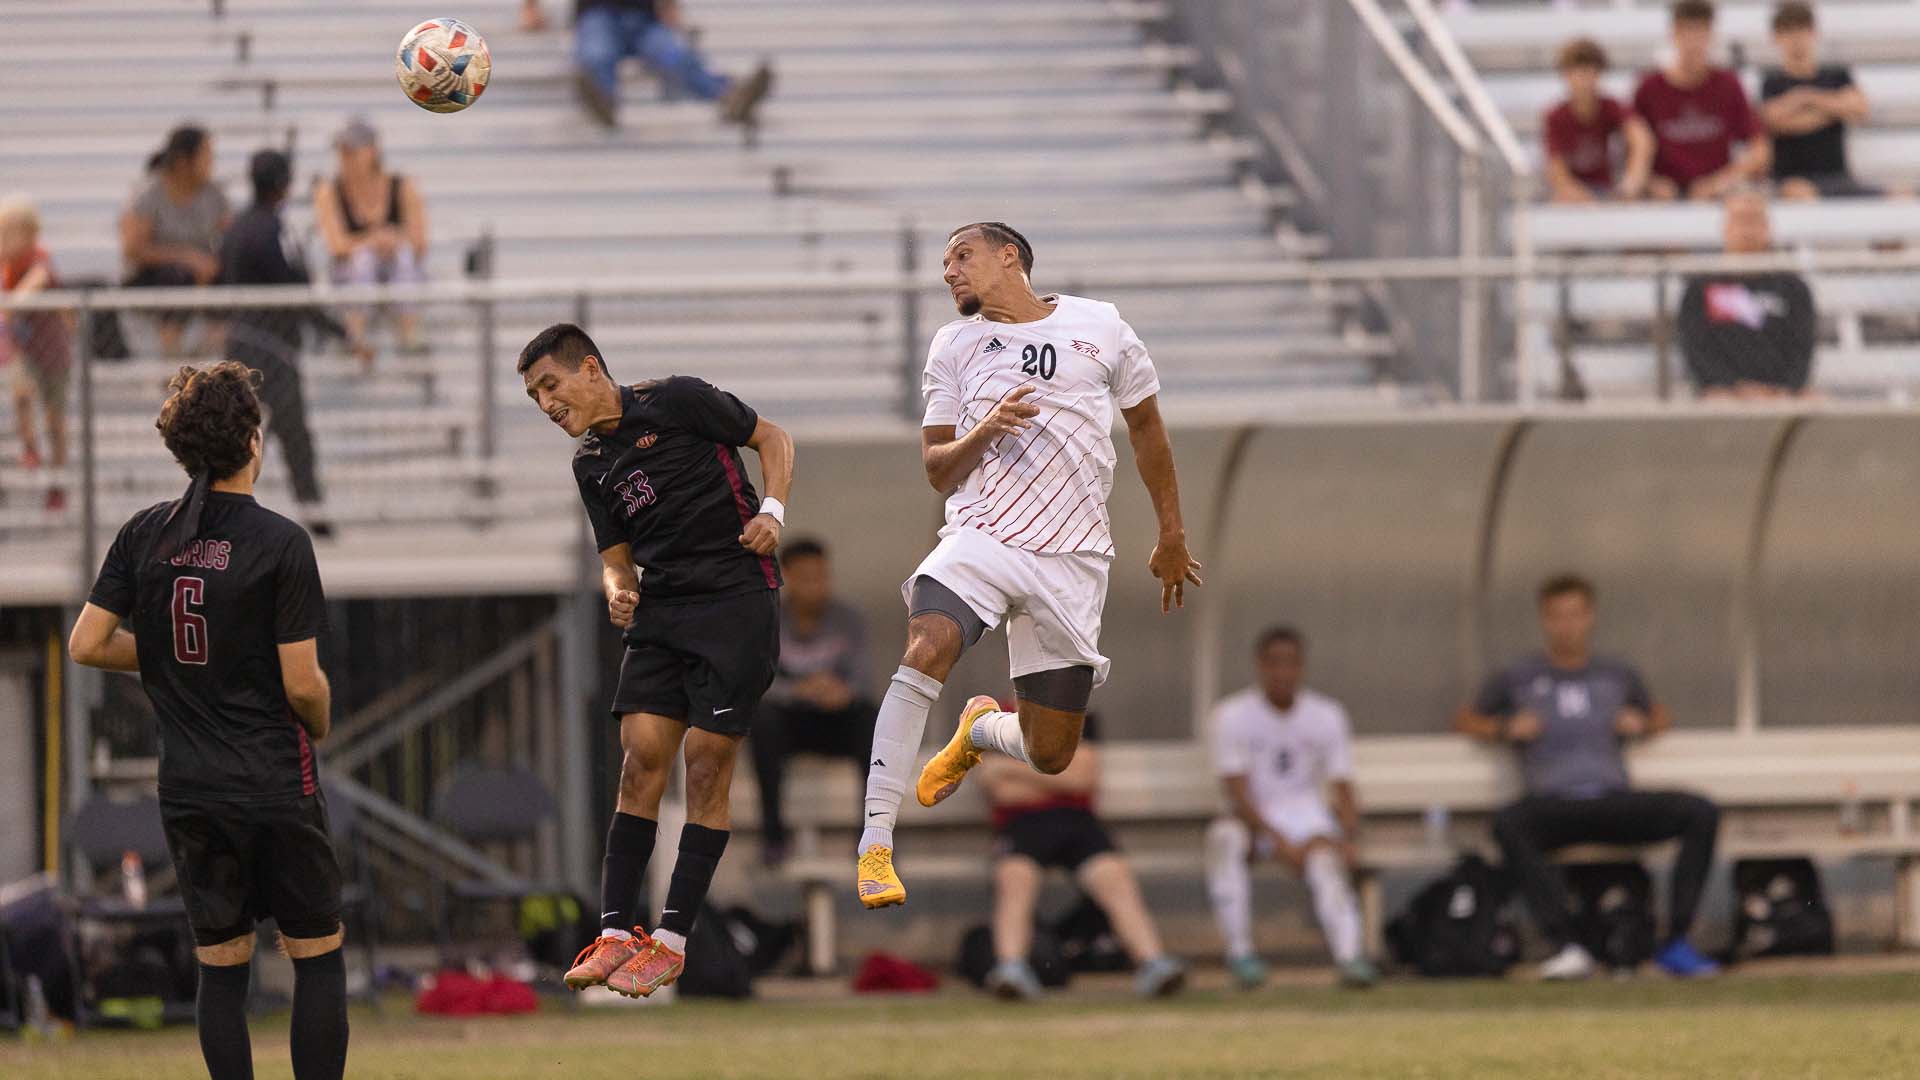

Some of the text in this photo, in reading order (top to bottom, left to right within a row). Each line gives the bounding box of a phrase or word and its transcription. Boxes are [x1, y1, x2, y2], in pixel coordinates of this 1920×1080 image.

[1022, 343, 1057, 381] 20
[613, 469, 657, 518] 33
[164, 538, 232, 570] ROS
[172, 576, 208, 665] 6
